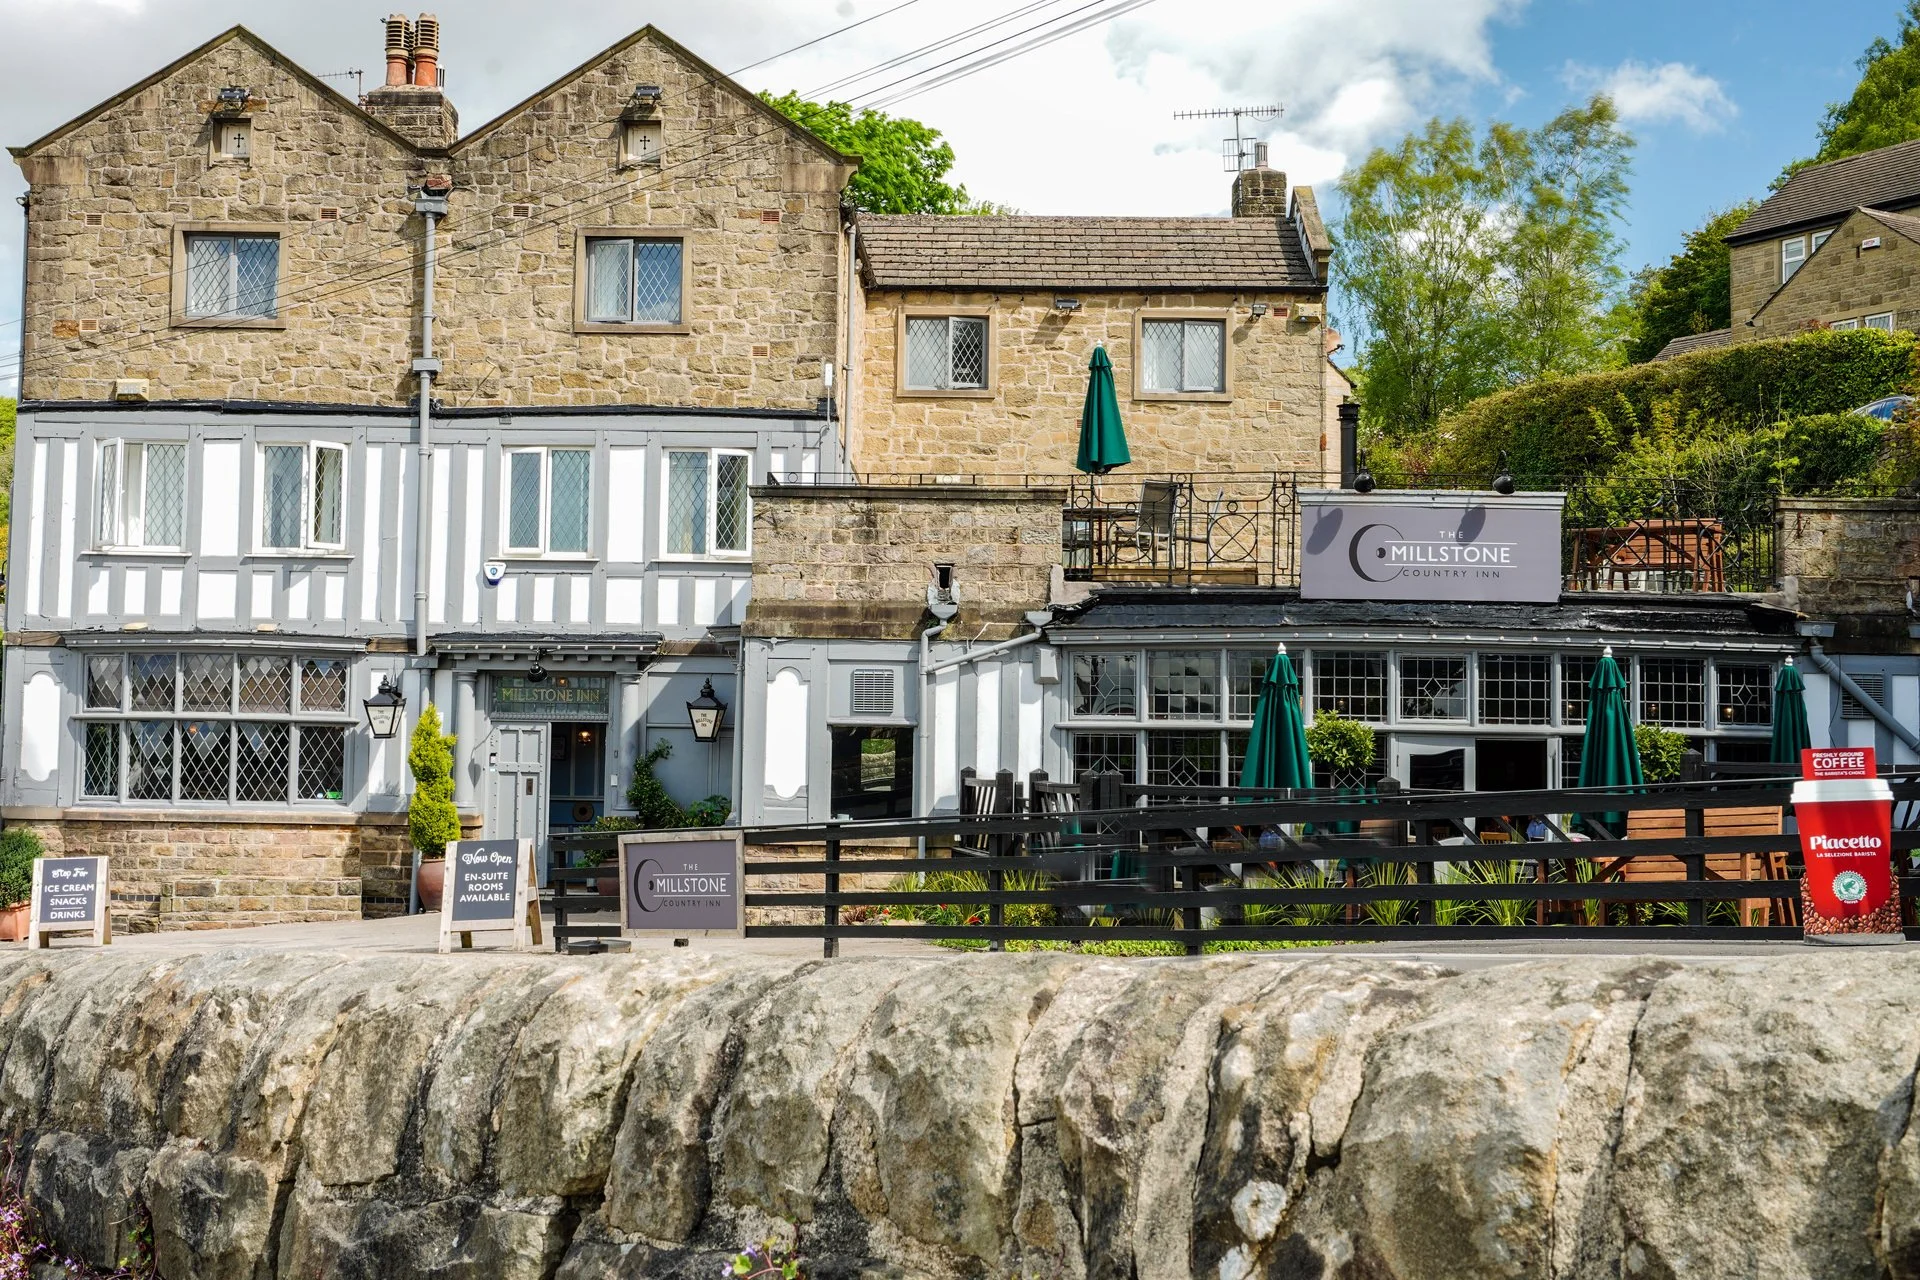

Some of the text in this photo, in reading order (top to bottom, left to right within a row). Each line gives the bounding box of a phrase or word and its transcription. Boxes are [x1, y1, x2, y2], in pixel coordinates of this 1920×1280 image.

[1440, 530, 1464, 538] THE
[1392, 546, 1510, 562] MILLSTONE
[502, 688, 600, 702] MILLSTONE INN
[1813, 757, 1865, 768] COFFEE
[1810, 835, 1881, 850] Piacetto
[462, 848, 512, 866] Now Open
[73, 868, 88, 877] For
[464, 872, 508, 881] EN-SUITE
[468, 883, 503, 891] ROOMS
[656, 878, 726, 892] MILLSTONE
[50, 898, 87, 906] SNACKS
[460, 893, 510, 902] AVAILABLE
[50, 911, 86, 919] DRINKS
